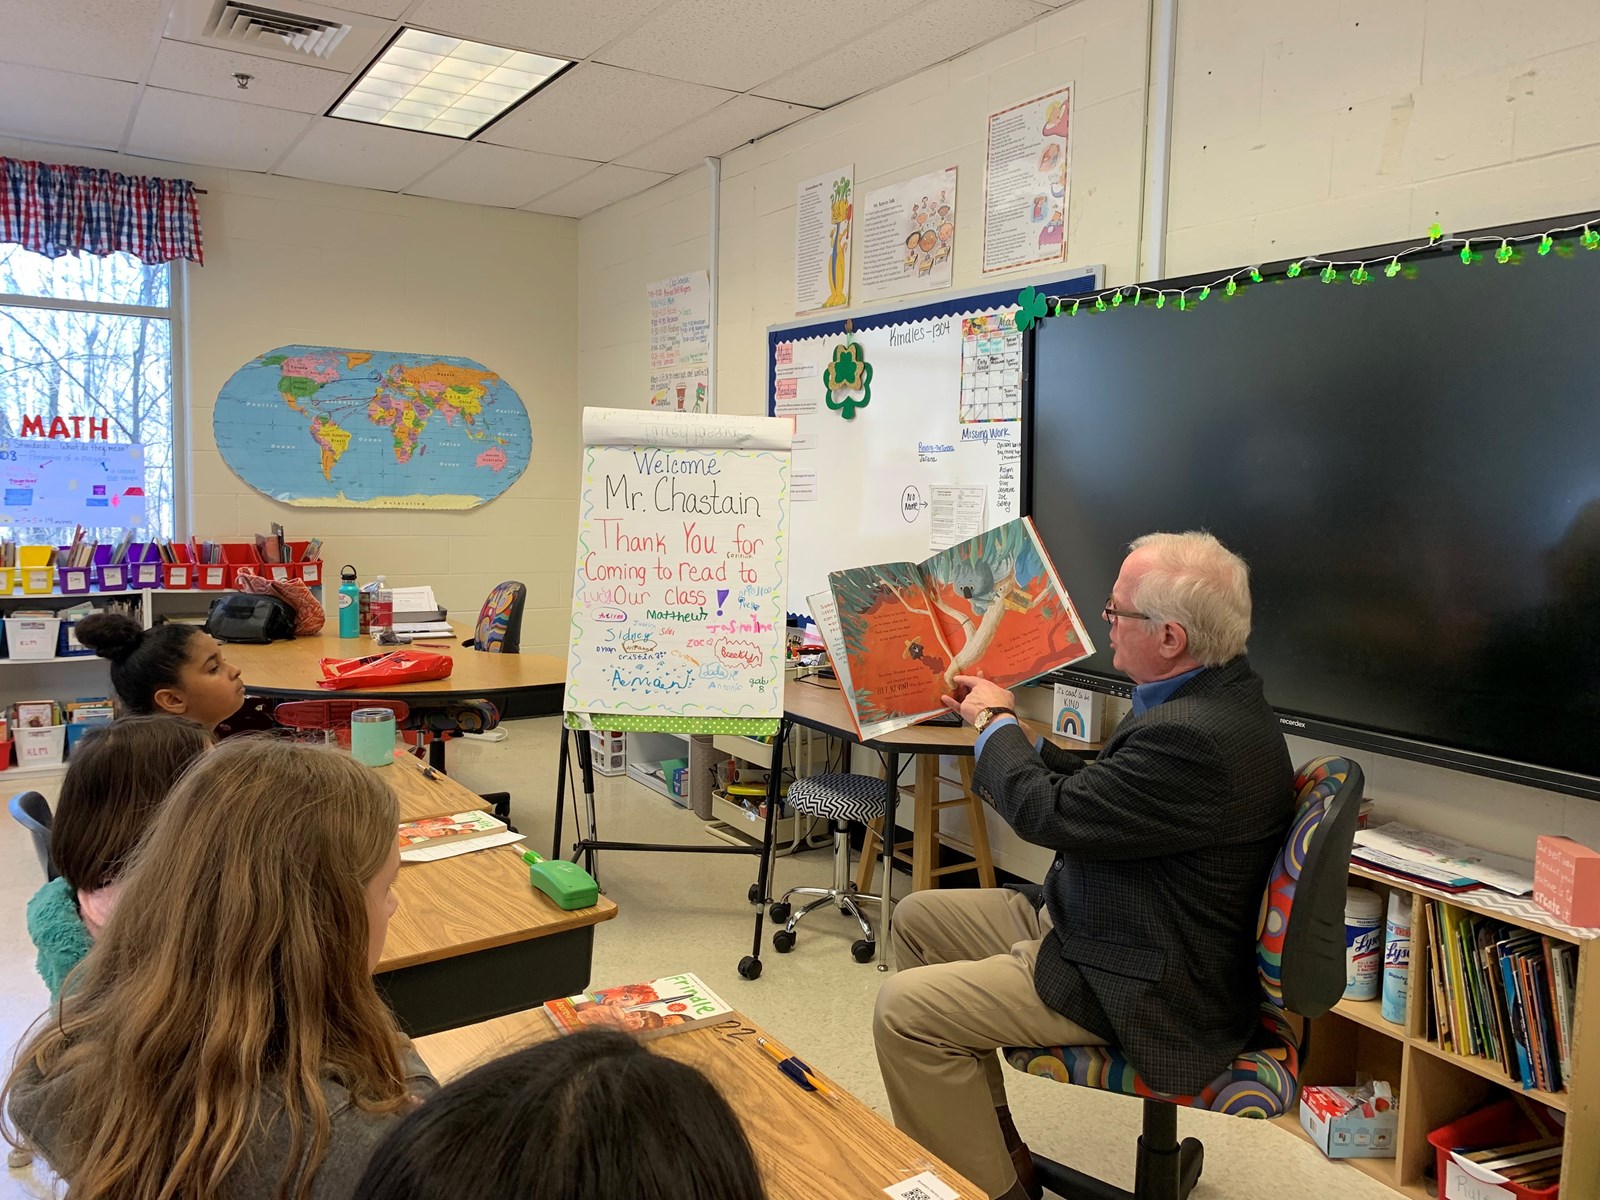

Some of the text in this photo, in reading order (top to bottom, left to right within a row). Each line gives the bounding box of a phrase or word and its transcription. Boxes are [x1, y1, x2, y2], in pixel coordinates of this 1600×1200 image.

[20, 414, 108, 439] MATH
[961, 427, 1011, 445] Missing Work
[633, 449, 721, 475] Welcome
[605, 474, 761, 517] Mr. Chastain
[593, 518, 764, 555] Thank You for
[585, 552, 758, 586] Coming to read to
[614, 585, 651, 605] Our
[604, 627, 653, 642] Sidney
[1064, 698, 1080, 709] KIND
[1535, 892, 1561, 915] create
[664, 975, 715, 1015] Frindle
